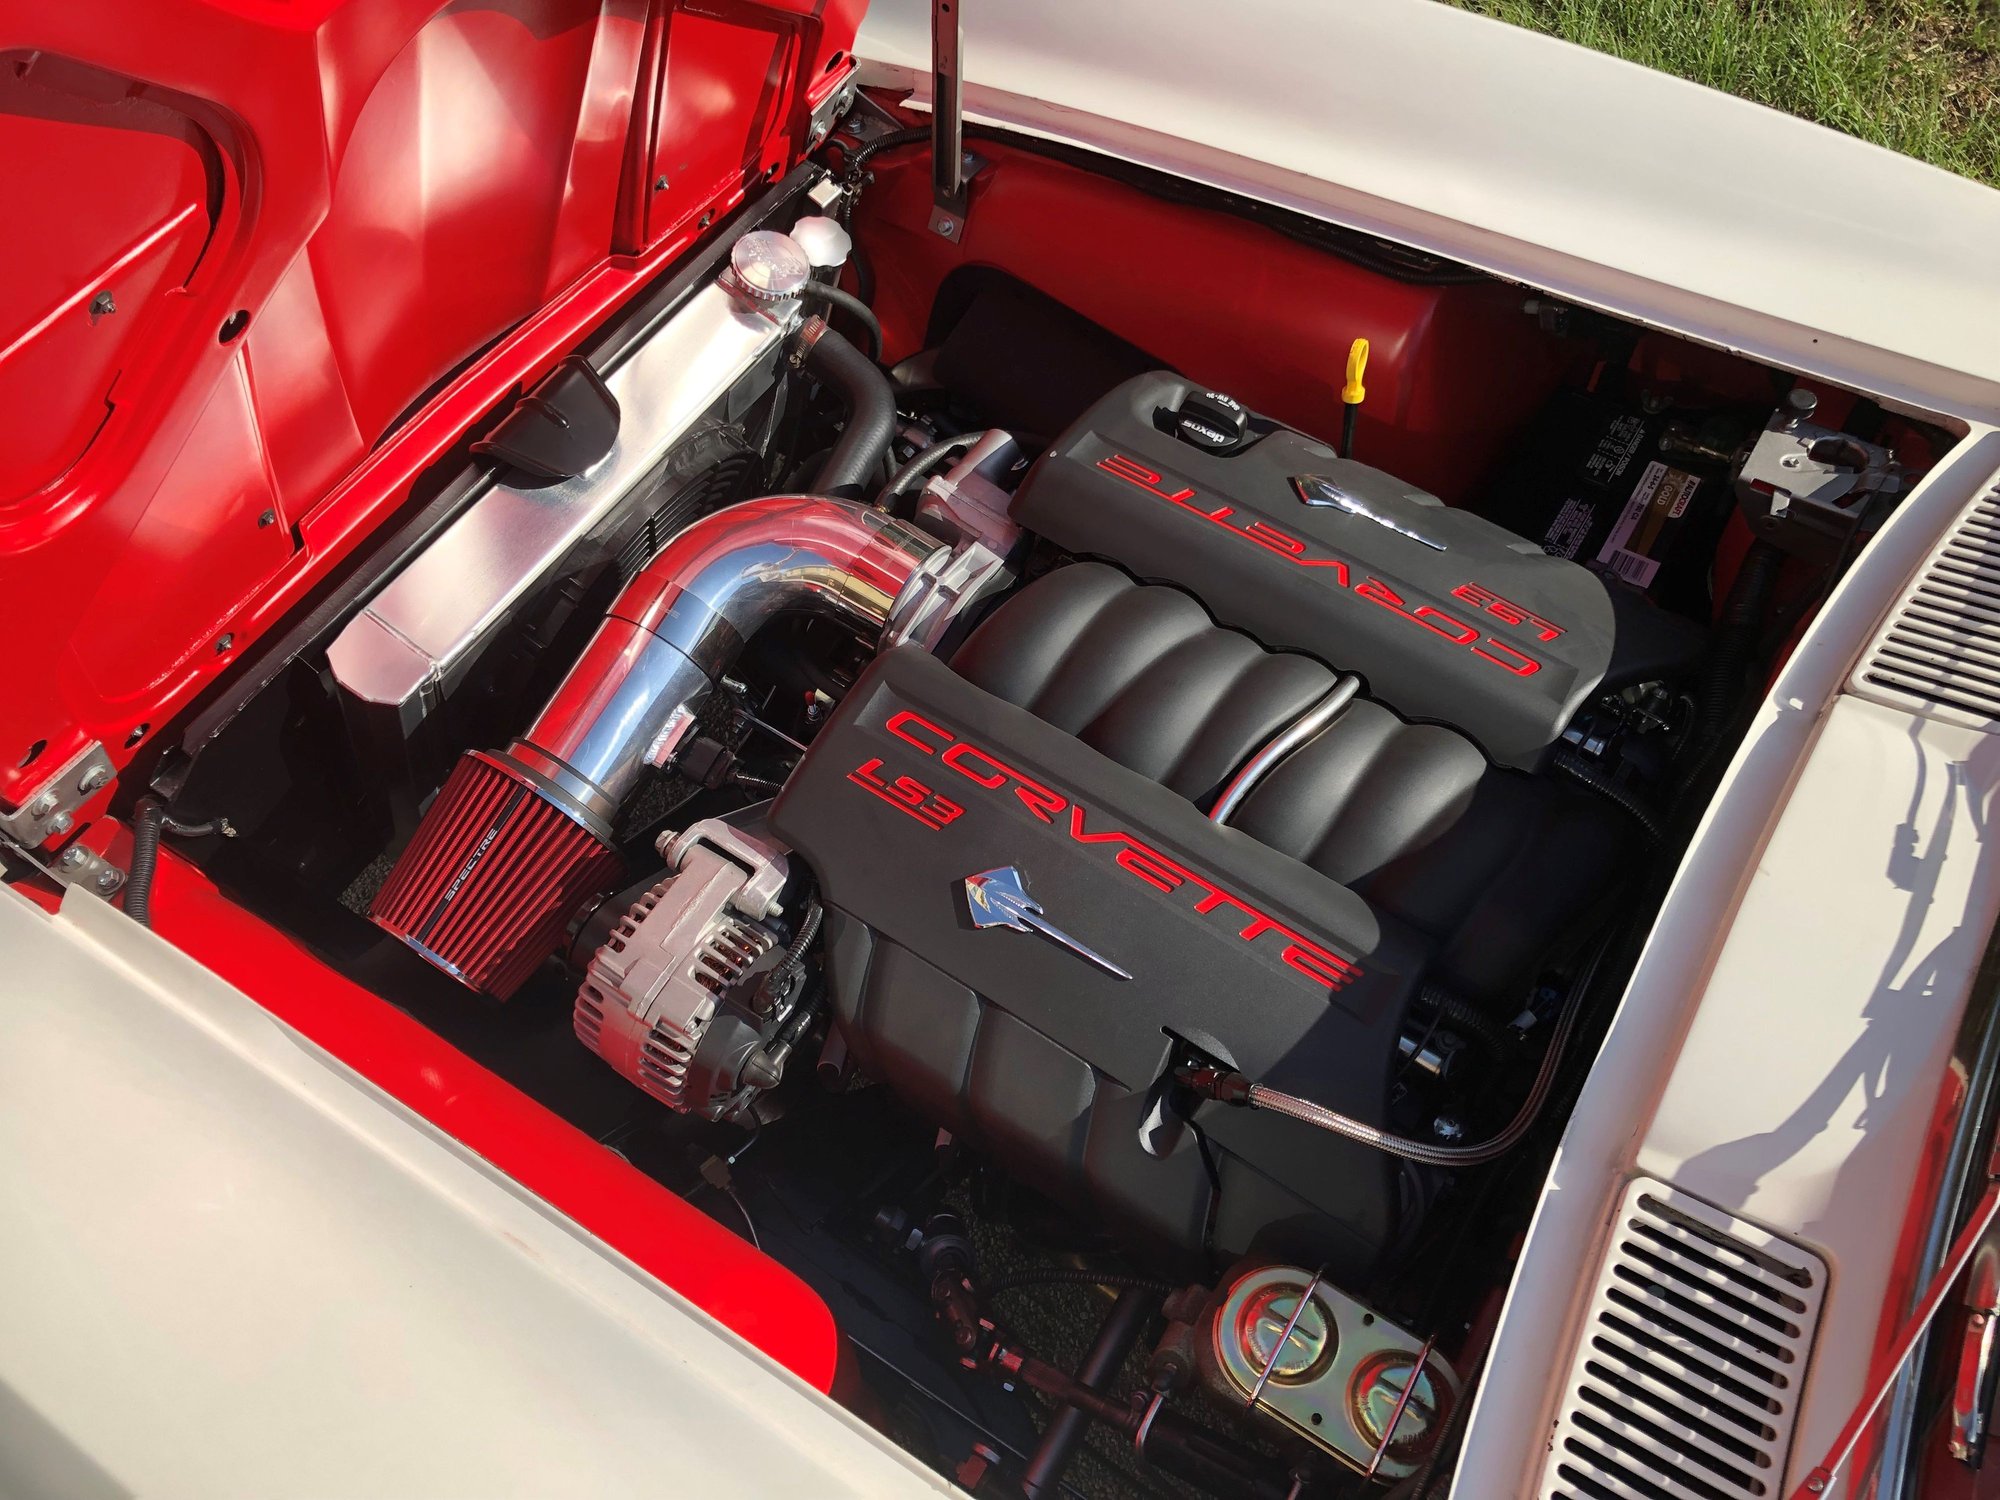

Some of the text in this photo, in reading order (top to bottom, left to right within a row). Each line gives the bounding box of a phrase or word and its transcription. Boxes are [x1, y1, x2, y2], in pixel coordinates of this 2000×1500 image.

[1181, 419, 1226, 444] dexos
[1655, 483, 1675, 507] GOLD
[1097, 454, 1541, 678] CORVETTE
[1450, 583, 1566, 643] LS3
[847, 757, 967, 831] LS3
[444, 827, 498, 902] SPECTRE
[885, 709, 1363, 991] CORVETTE
